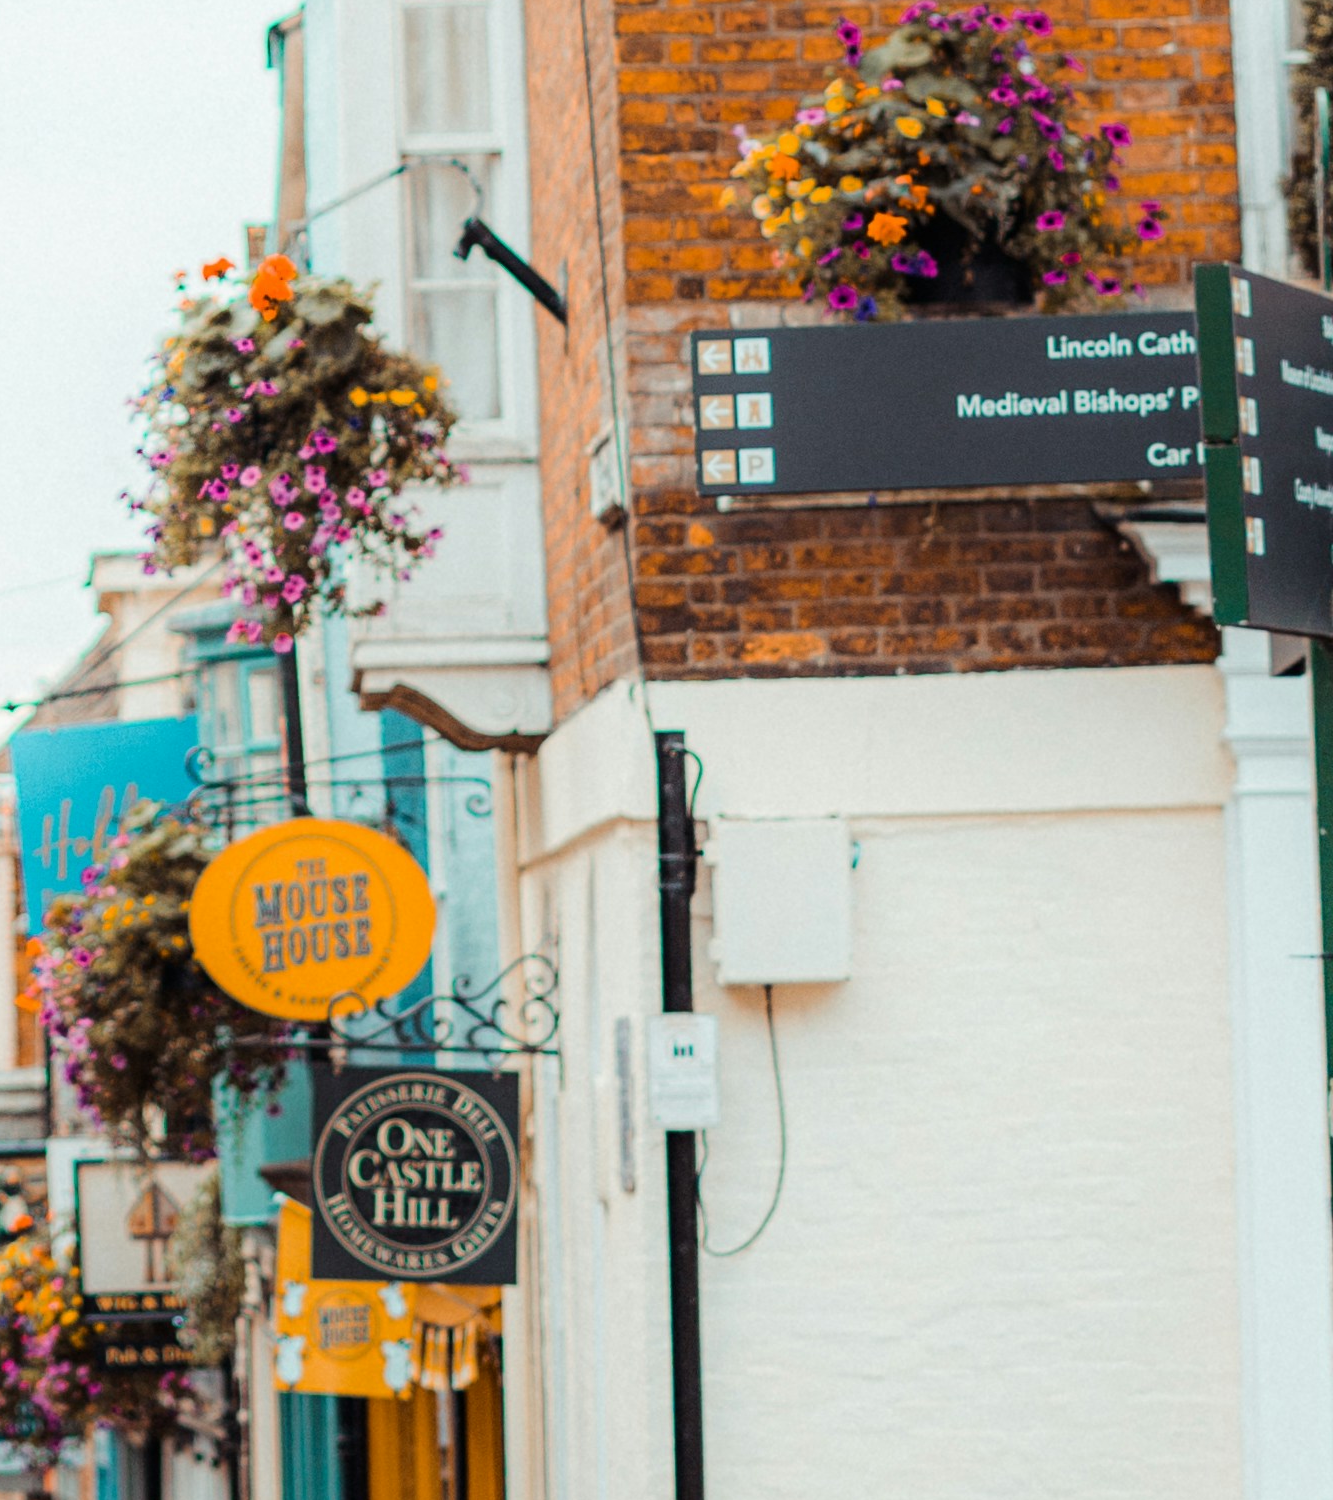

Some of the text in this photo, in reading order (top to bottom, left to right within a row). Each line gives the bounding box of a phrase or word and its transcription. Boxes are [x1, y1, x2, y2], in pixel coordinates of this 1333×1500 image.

[1046, 332, 1133, 359] Lincoln
[957, 389, 1068, 418] Medieval
[1146, 442, 1192, 467] Car
[294, 858, 326, 877] THE
[253, 872, 370, 929] MOUSE
[261, 917, 373, 973] HOUSE
[333, 1083, 500, 1143] PATISSERIE DELI
[376, 1117, 457, 1160] ONE
[347, 1149, 484, 1193] CASTLE
[372, 1187, 460, 1229] HILL
[327, 1192, 506, 1270] HOMEWARES GIFTS
